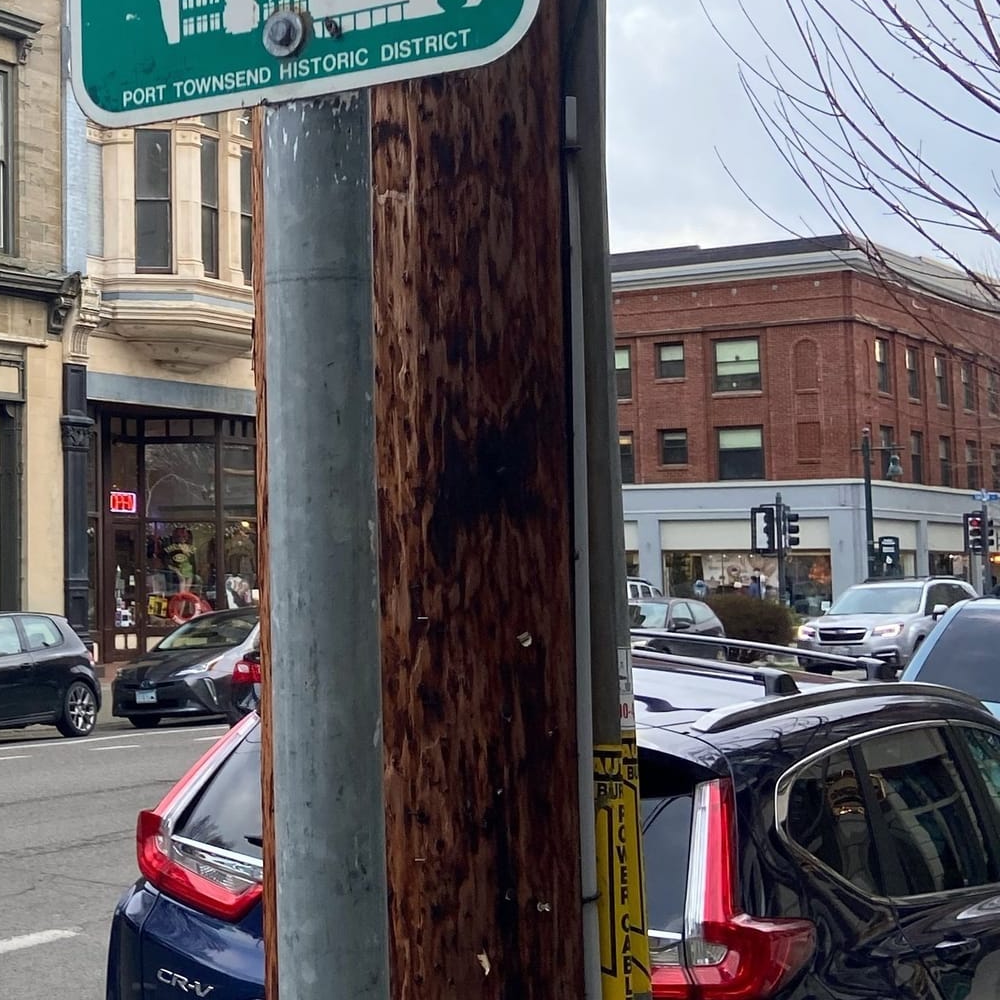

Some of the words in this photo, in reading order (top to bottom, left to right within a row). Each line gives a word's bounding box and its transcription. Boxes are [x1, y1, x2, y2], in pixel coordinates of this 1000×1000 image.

[123, 85, 166, 107] PORT
[173, 67, 271, 100] TOWNSEND
[279, 48, 369, 77] HISTORIC
[381, 28, 471, 62] DISTRICT
[156, 968, 214, 998] CR-V
[621, 913, 633, 1000] CABL
